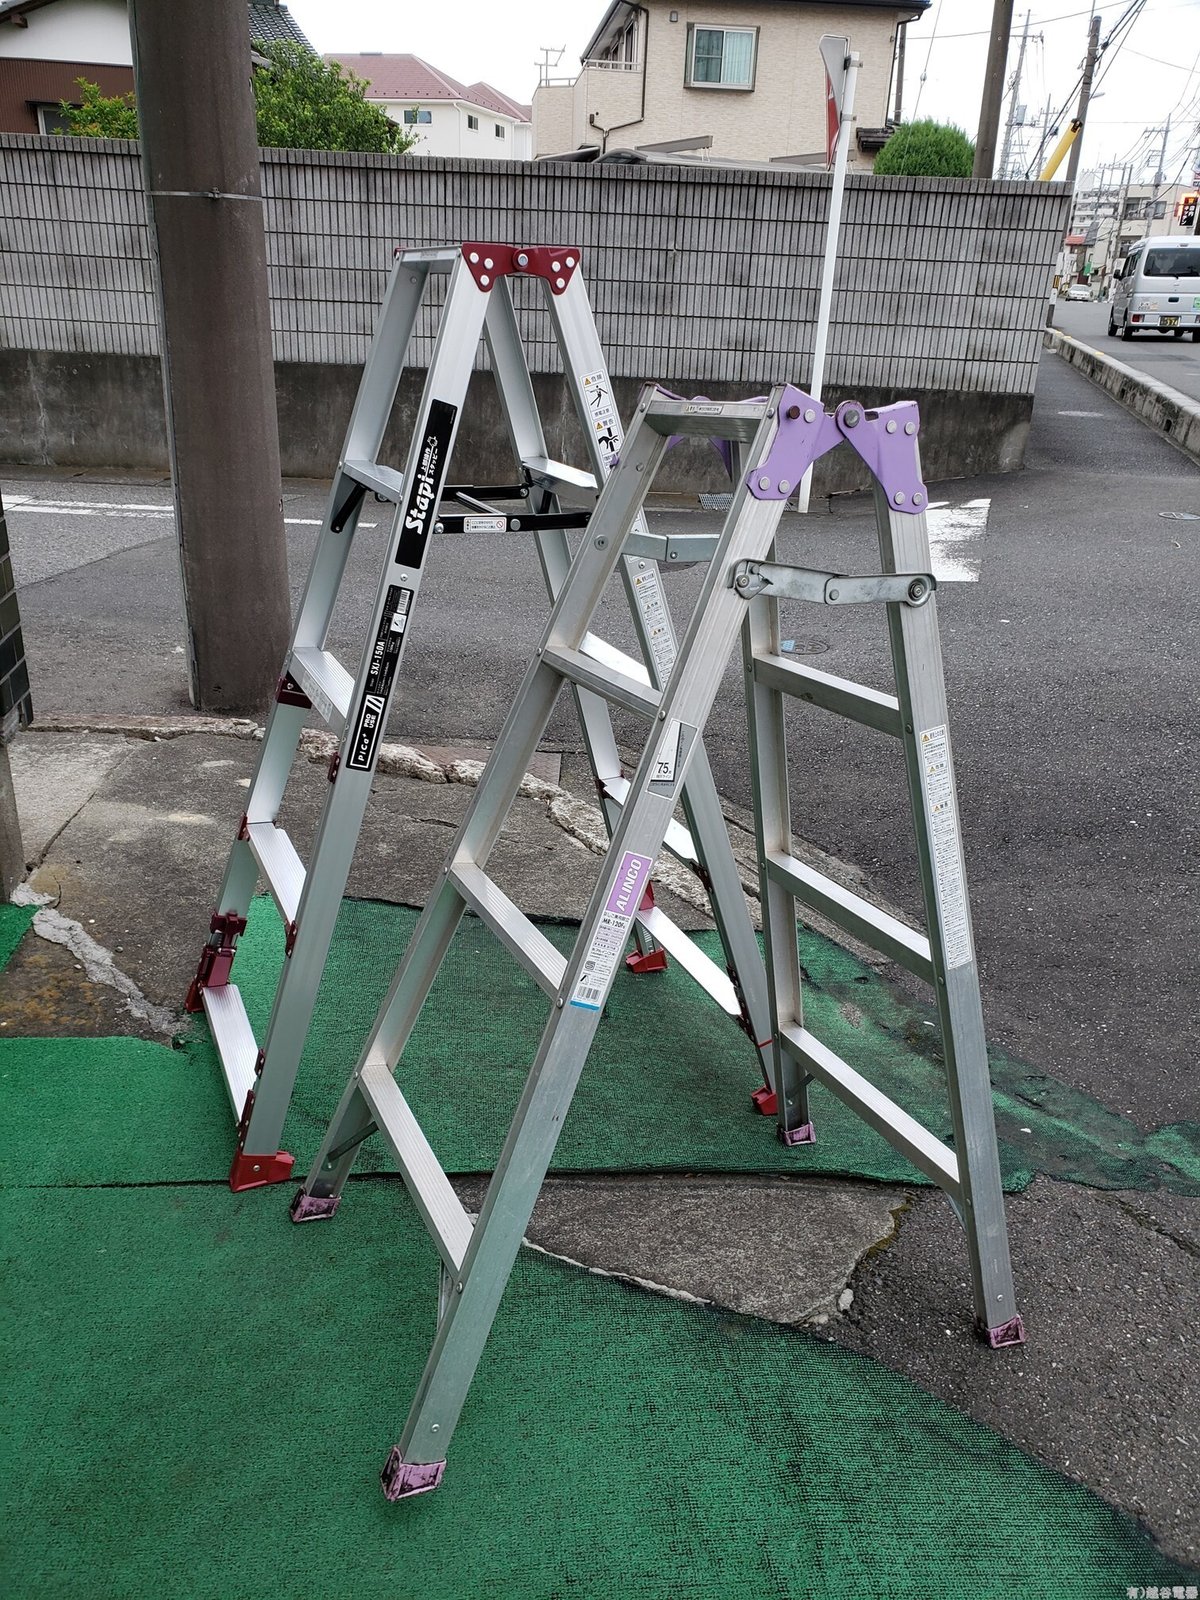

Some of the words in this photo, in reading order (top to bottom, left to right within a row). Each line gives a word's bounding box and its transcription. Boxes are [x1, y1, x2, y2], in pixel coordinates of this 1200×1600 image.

[405, 474, 435, 535] Stapi
[370, 641, 386, 675] SXJ-150A
[363, 714, 371, 728] PRO
[368, 715, 377, 729] USE
[615, 858, 642, 912] ALINCO
